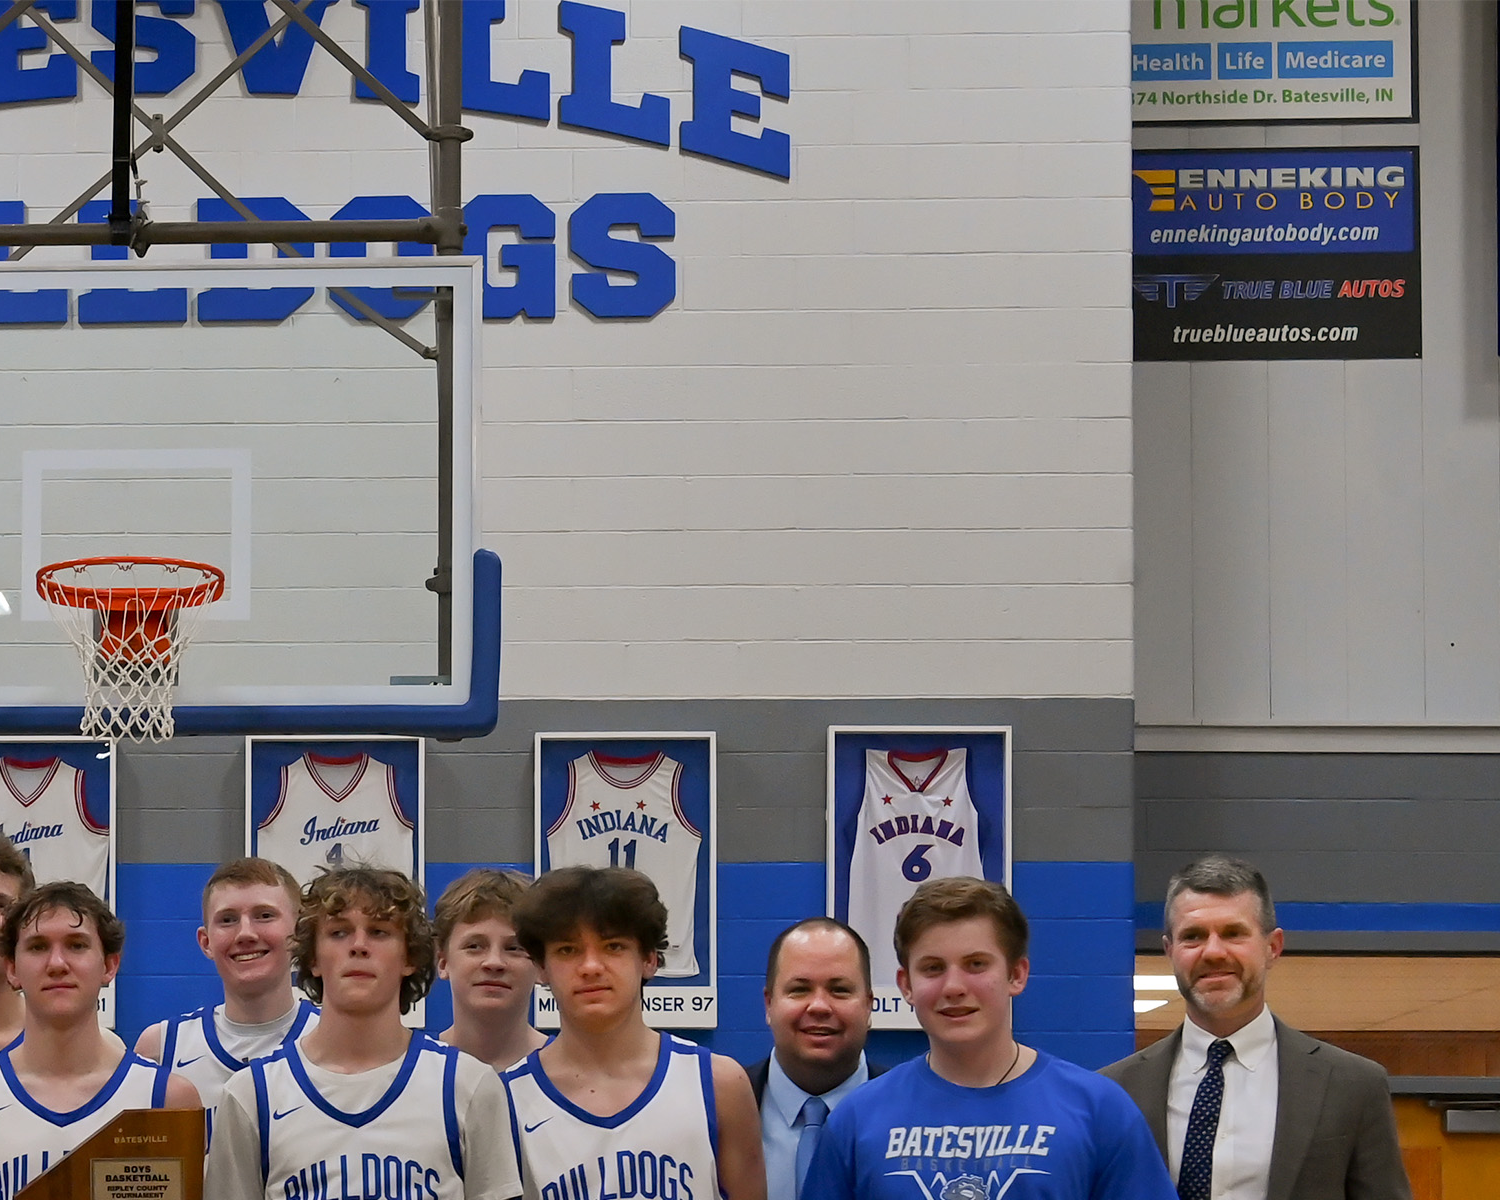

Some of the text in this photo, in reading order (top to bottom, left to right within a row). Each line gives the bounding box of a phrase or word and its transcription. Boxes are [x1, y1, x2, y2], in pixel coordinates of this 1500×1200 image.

[1132, 53, 1204, 71] Health
[1225, 52, 1264, 70] Life
[1285, 51, 1386, 69] Medicare
[1162, 89, 1248, 105] Northside
[1253, 90, 1277, 104] Dr.
[1282, 88, 1369, 104] Batesville,
[1375, 88, 1393, 102] IN
[1178, 166, 1405, 189] ENNEKING
[1179, 192, 1399, 210] AUTO BODY
[1150, 223, 1379, 246] ennekingautobody.com
[1221, 279, 1406, 300] TRUE BLUE AUTOS
[1173, 324, 1358, 343] trueblueautos.com
[300, 816, 380, 845] Indiana
[576, 810, 668, 843] INDIANA
[869, 814, 965, 847] INDIANA
[326, 843, 344, 869] 4
[608, 838, 636, 870] 11
[901, 844, 934, 882] 6
[692, 996, 714, 1012] 97
[114, 1135, 168, 1144] BATESVILLE
[885, 1125, 1056, 1159] BATESVILLE
[105, 1174, 170, 1182] BASKETBALL
[124, 1165, 151, 1173] BOYS
